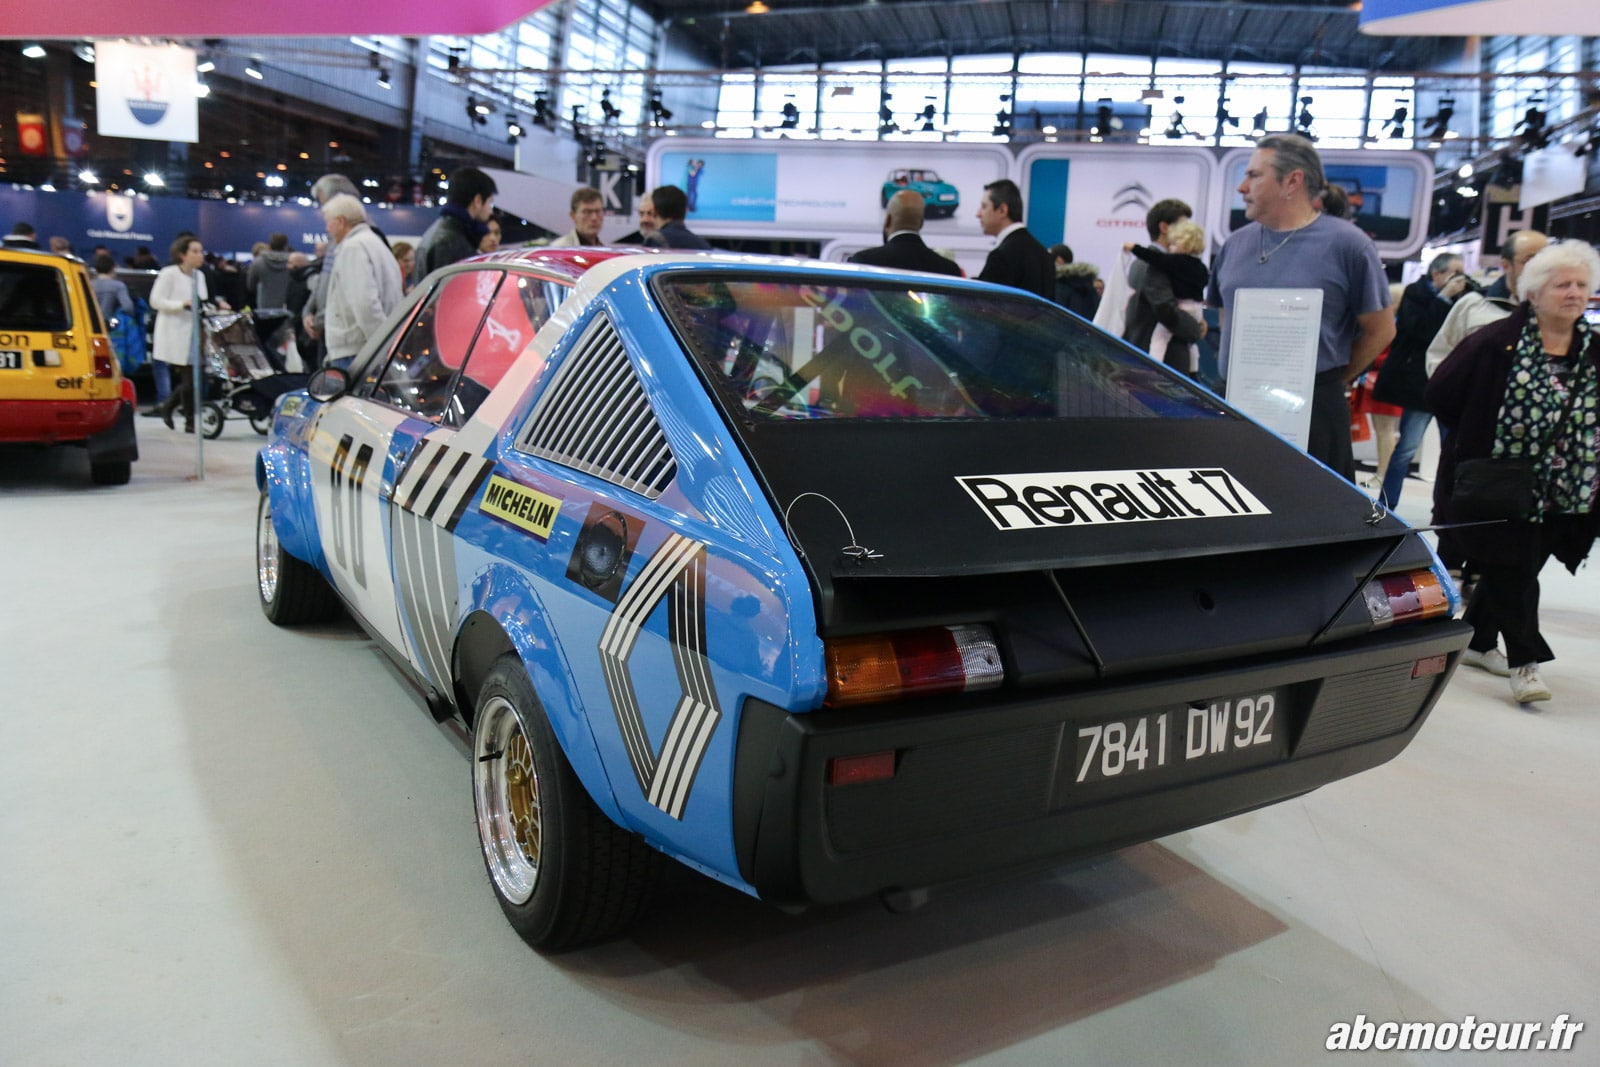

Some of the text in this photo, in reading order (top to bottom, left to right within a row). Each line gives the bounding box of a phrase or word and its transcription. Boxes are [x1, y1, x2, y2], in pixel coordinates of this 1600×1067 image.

[600, 171, 623, 209] K
[1095, 219, 1148, 228] CITRO
[56, 377, 83, 389] elf
[486, 483, 555, 529] MICHELIN
[961, 469, 1253, 529] Renault 17
[1076, 713, 1167, 783] 7841
